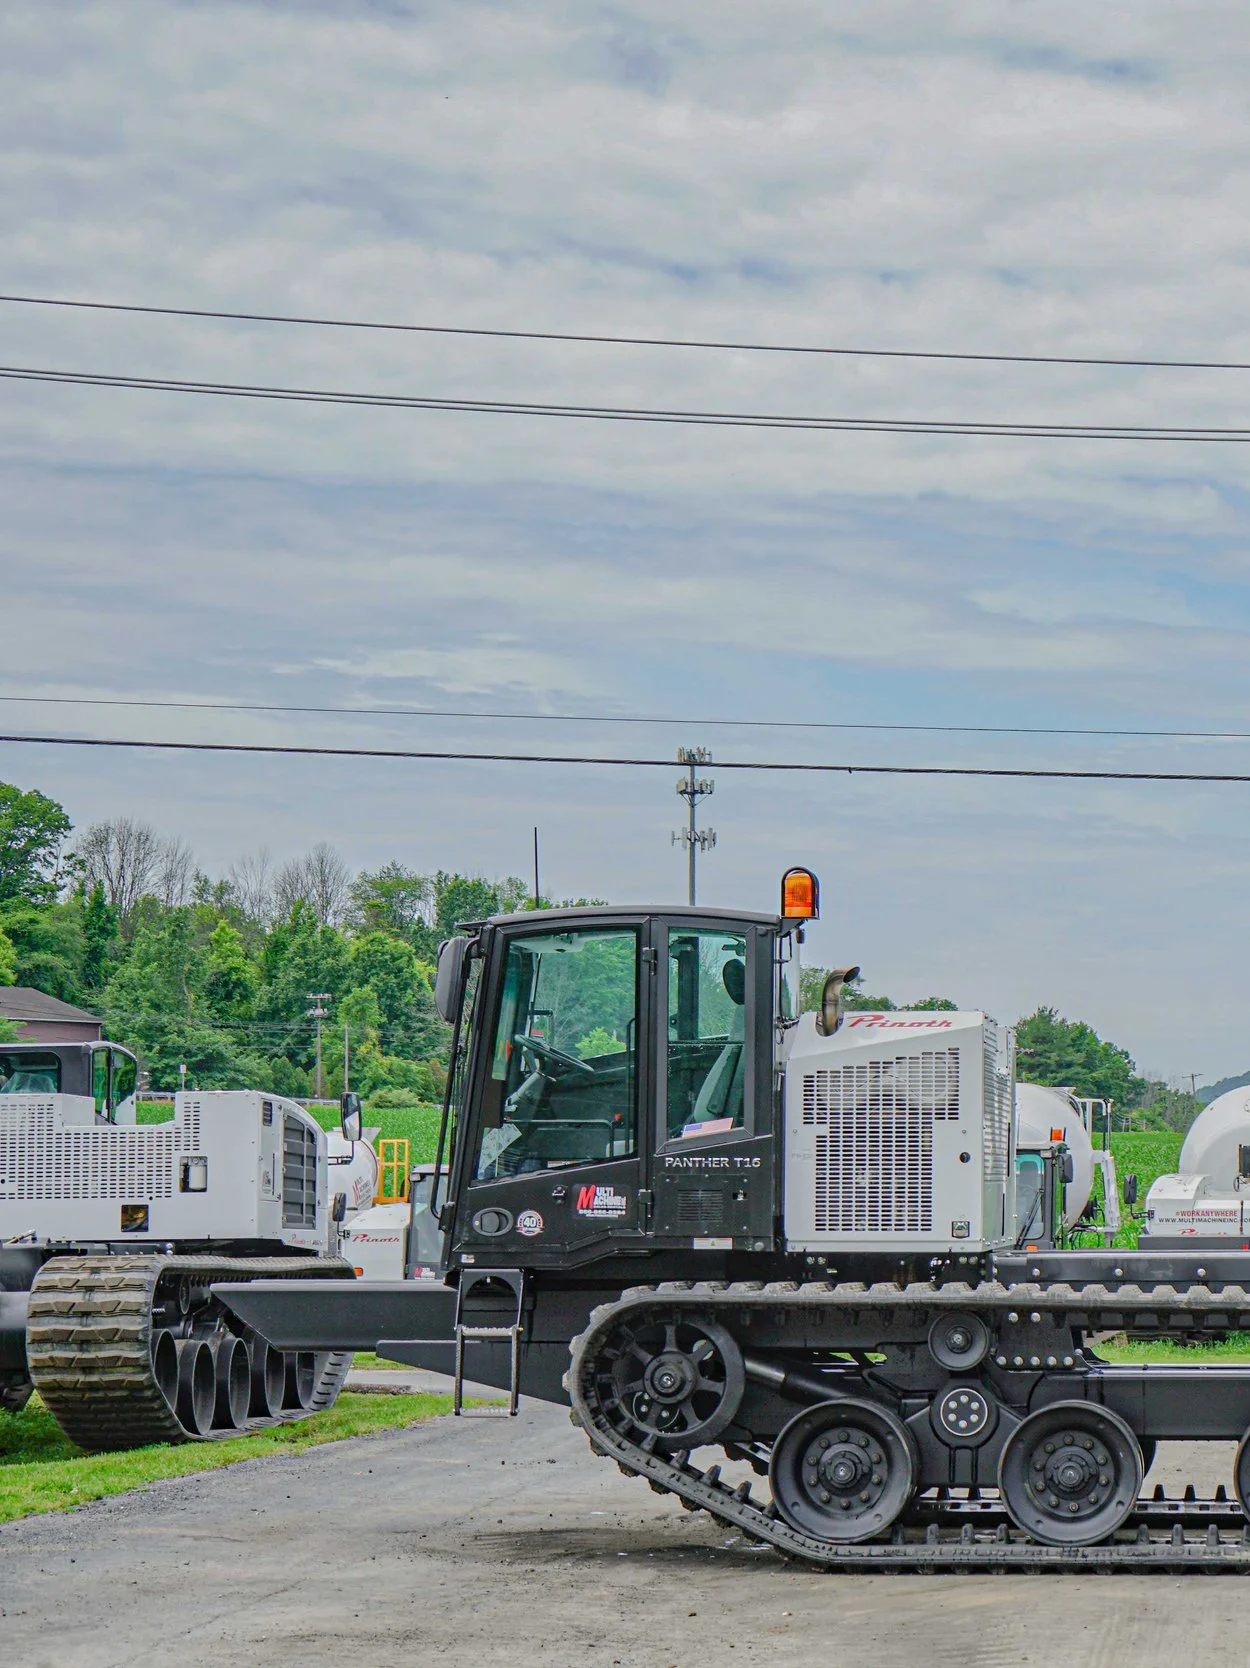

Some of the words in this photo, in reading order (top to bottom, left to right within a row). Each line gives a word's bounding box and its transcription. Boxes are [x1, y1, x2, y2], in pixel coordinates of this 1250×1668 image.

[846, 1014, 954, 1028] Prinoth
[665, 1157, 730, 1168] PANTHER
[733, 1157, 761, 1168] T16
[523, 1217, 537, 1228] 40
[352, 1233, 400, 1243] Prinoth
